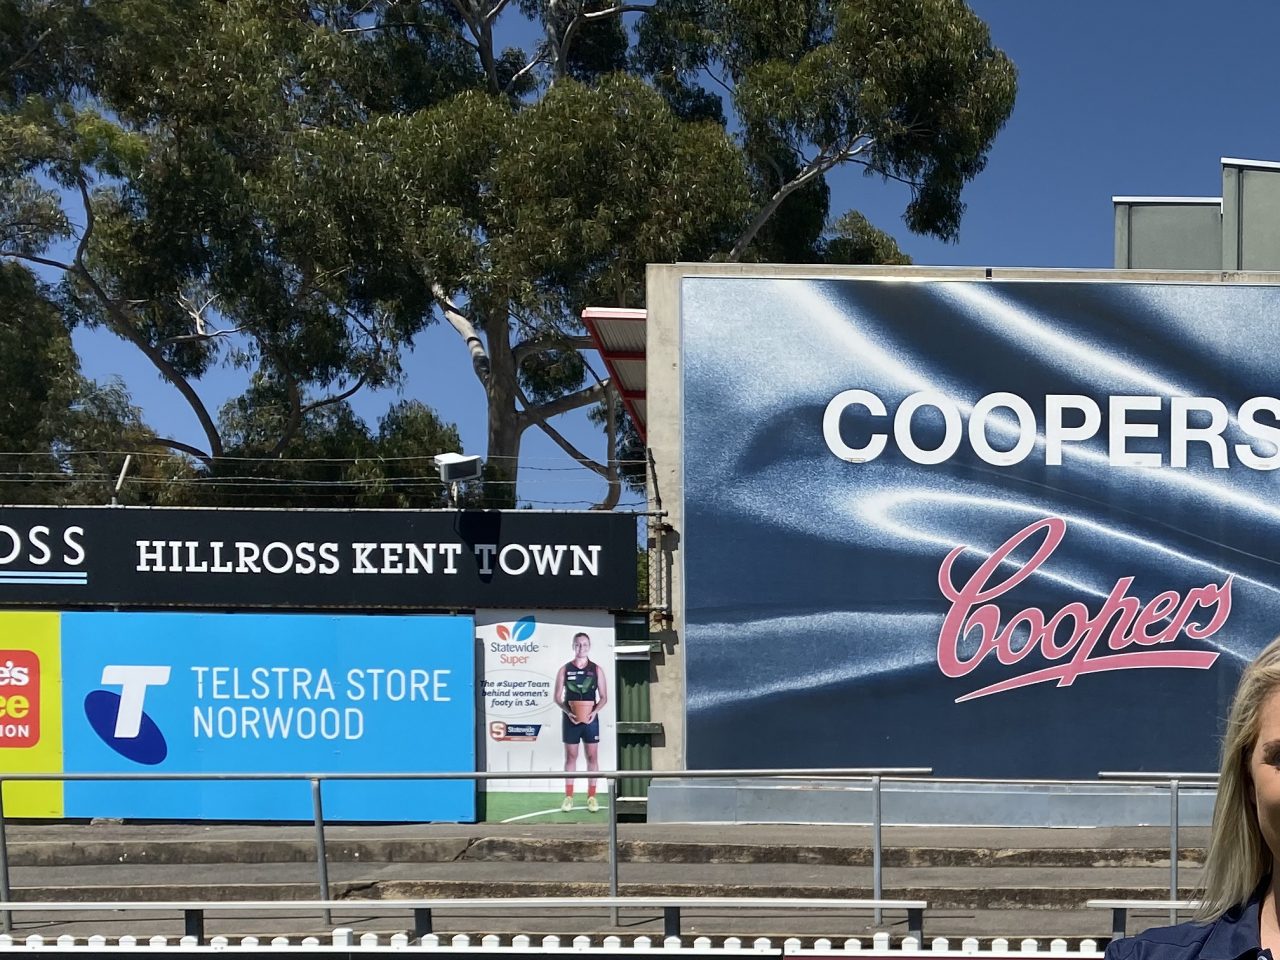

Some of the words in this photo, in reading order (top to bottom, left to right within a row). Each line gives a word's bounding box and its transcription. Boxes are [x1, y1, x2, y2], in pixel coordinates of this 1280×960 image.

[135, 540, 340, 575] HILLROSS
[351, 542, 462, 574] KENT
[474, 543, 602, 577] TOWN
[936, 516, 1234, 700] Coopers
[490, 642, 539, 652] Statewide
[500, 654, 529, 666] Super
[190, 666, 336, 700] TELSTRA
[347, 668, 451, 702] STORE
[480, 680, 495, 688] The
[481, 689, 511, 697] behind
[512, 689, 549, 697] women's
[490, 698, 514, 708] footy
[515, 698, 523, 706] in
[525, 699, 538, 707] SA.
[193, 706, 364, 740] NORWOOD
